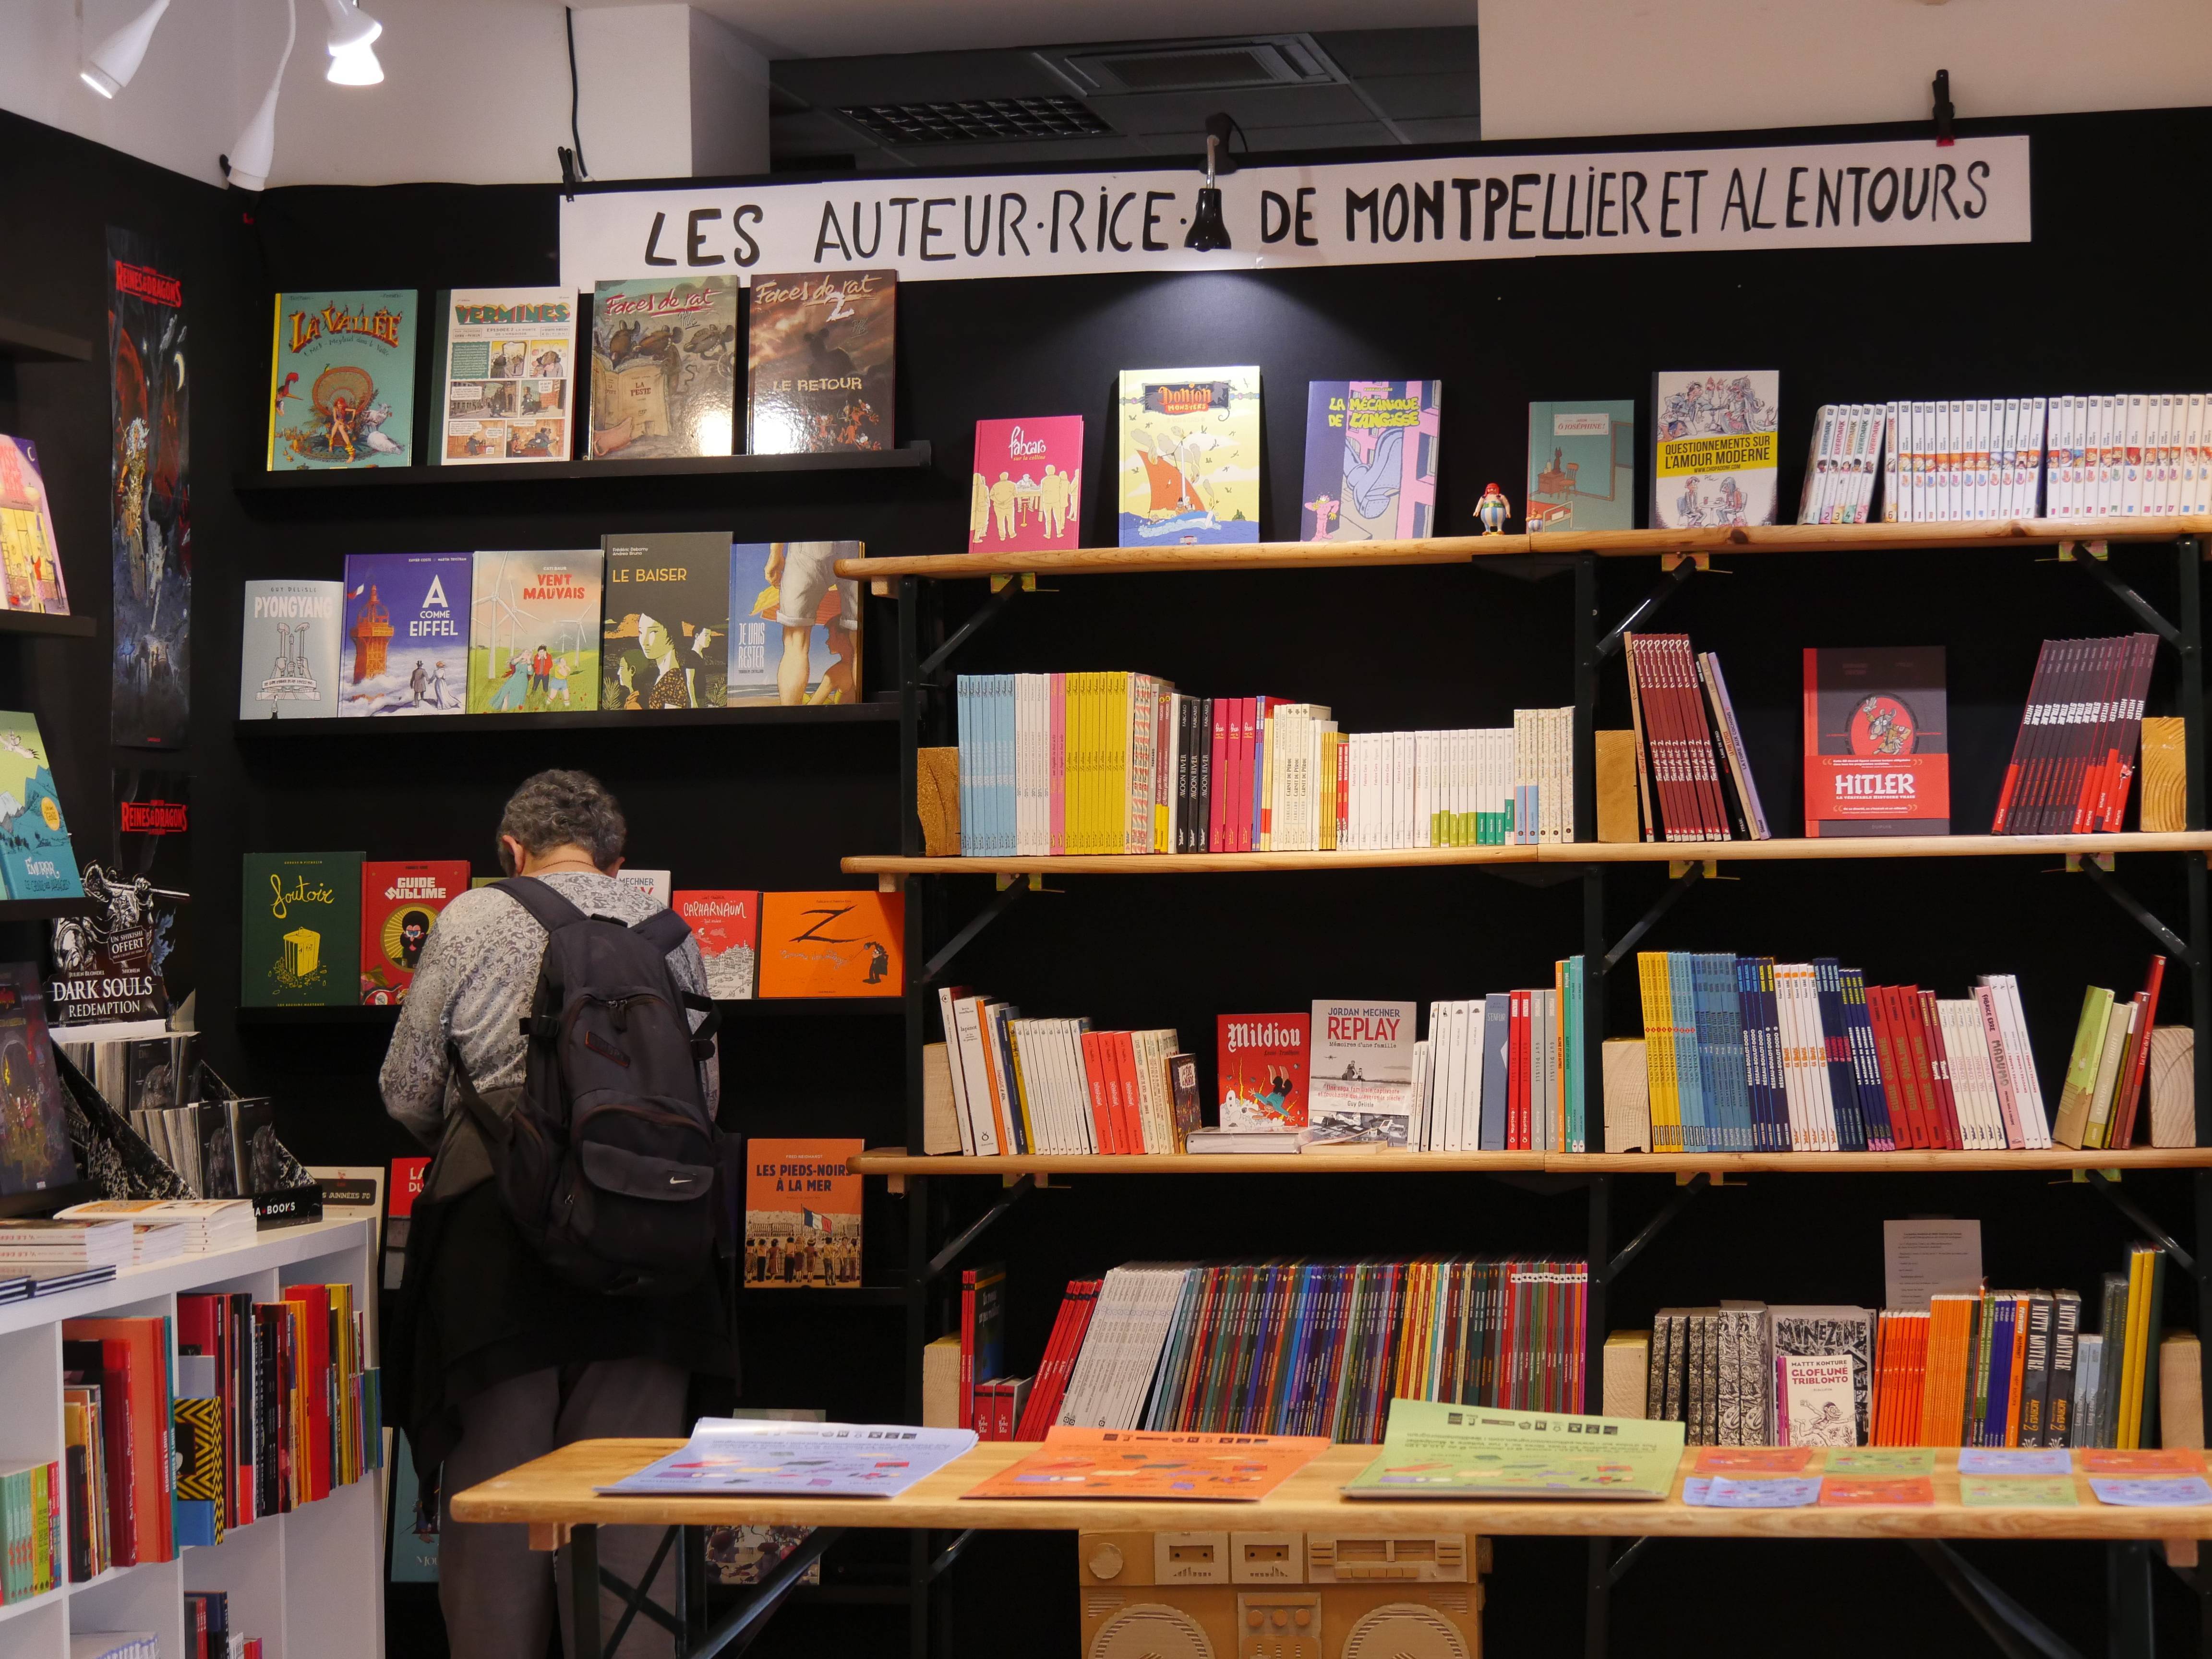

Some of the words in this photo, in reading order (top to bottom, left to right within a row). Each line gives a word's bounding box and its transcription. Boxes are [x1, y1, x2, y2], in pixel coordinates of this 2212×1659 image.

[645, 204, 763, 267] LES
[814, 186, 1188, 264] AUTEUR·RICE·
[1261, 187, 1318, 246] DE
[1660, 169, 1708, 238] ET
[1721, 160, 1990, 232] ALENTOURS
[755, 281, 809, 305] Faces
[813, 274, 835, 300] de
[842, 274, 883, 294] rat
[604, 293, 655, 317] Faces
[657, 288, 680, 311] de
[685, 287, 723, 307] rat
[826, 291, 854, 323] 2
[455, 302, 570, 325] VERMINES
[288, 311, 323, 354] LA
[320, 305, 402, 349] VALLÉE
[630, 387, 651, 397] PESTE
[772, 381, 790, 392] LE
[797, 377, 863, 392] RETOUR
[1158, 383, 1212, 406] Donjon
[1329, 397, 1346, 411] LA
[1328, 414, 1344, 427] DE
[1565, 421, 1602, 431] JOSÉPHINE
[1665, 437, 1751, 455] QUESTIONNEMENTS
[1753, 435, 1771, 447] SUR
[1821, 419, 1833, 456] EVERDARK
[1833, 419, 1845, 456] EVERDARK
[1845, 419, 1857, 456] EVERDARK
[1856, 419, 1869, 455] EVERDARK
[1868, 419, 1881, 455] EVERDARK
[1665, 452, 1712, 469] L'AMOUR
[1715, 447, 1770, 465] MODERNE
[1812, 512, 1815, 521] 1
[1824, 511, 1830, 520] 2
[1835, 512, 1840, 521] 3
[1845, 510, 1851, 520] 4
[1857, 511, 1863, 520] 5
[1887, 510, 1893, 520] 6
[537, 574, 572, 586] VENT
[613, 569, 629, 582] LE
[636, 567, 687, 582] BAISER
[422, 574, 448, 608] A
[523, 587, 585, 600] MAUVAIS
[254, 596, 333, 619] PYONGYANG
[420, 610, 450, 619] COMME
[409, 620, 458, 637] EIFFEL
[739, 623, 747, 645] JE
[748, 622, 765, 645] VAIS
[738, 646, 764, 668] RESTER
[1727, 711, 1737, 733] COCHONS
[2023, 705, 2034, 725] HITLER
[2100, 702, 2110, 723] HITLER
[2109, 701, 2119, 722] HITLER
[1835, 773, 1916, 795] HITLER
[121, 802, 150, 832] REINES
[155, 805, 188, 832] DRAGONS
[385, 886, 446, 900] SUBLIME
[397, 877, 436, 888] GUIDE
[684, 900, 747, 919] CAPHARNAÜM
[789, 904, 873, 943] Z
[112, 937, 144, 954] OFFERT
[120, 930, 143, 941] SHIKISHI
[52, 979, 100, 1002] DARK
[102, 975, 153, 998] SOULS
[69, 1000, 140, 1018] REDEMPTION
[1328, 1007, 1359, 1016] JORDAN
[1363, 1008, 1400, 1018] MECHNER
[1982, 994, 1992, 1016] FABRICE
[1987, 1017, 1996, 1032] ERRE
[960, 1025, 977, 1033] lapinot
[1228, 1022, 1301, 1053] Mildiou
[1327, 1016, 1401, 1041] REPLAY
[1992, 1039, 2009, 1087] MADUMO
[756, 1164, 776, 1177] LES
[780, 1164, 853, 1177] PIEDS-NOIRS
[776, 1178, 784, 1191] À
[789, 1179, 802, 1191] LA
[806, 1179, 831, 1191] MER
[266, 1202, 296, 1215] BOOKS
[2031, 1304, 2049, 1332] MATTT
[2057, 1304, 2076, 1332] MATTT
[2027, 1334, 2046, 1371] KONTURE
[2054, 1334, 2074, 1371] KONTURE
[1792, 1376, 1848, 1384] TRIBLONTO
[2030, 1399, 2040, 1423] ARCHIVES
[2057, 1399, 2067, 1423] ARCHIVES
